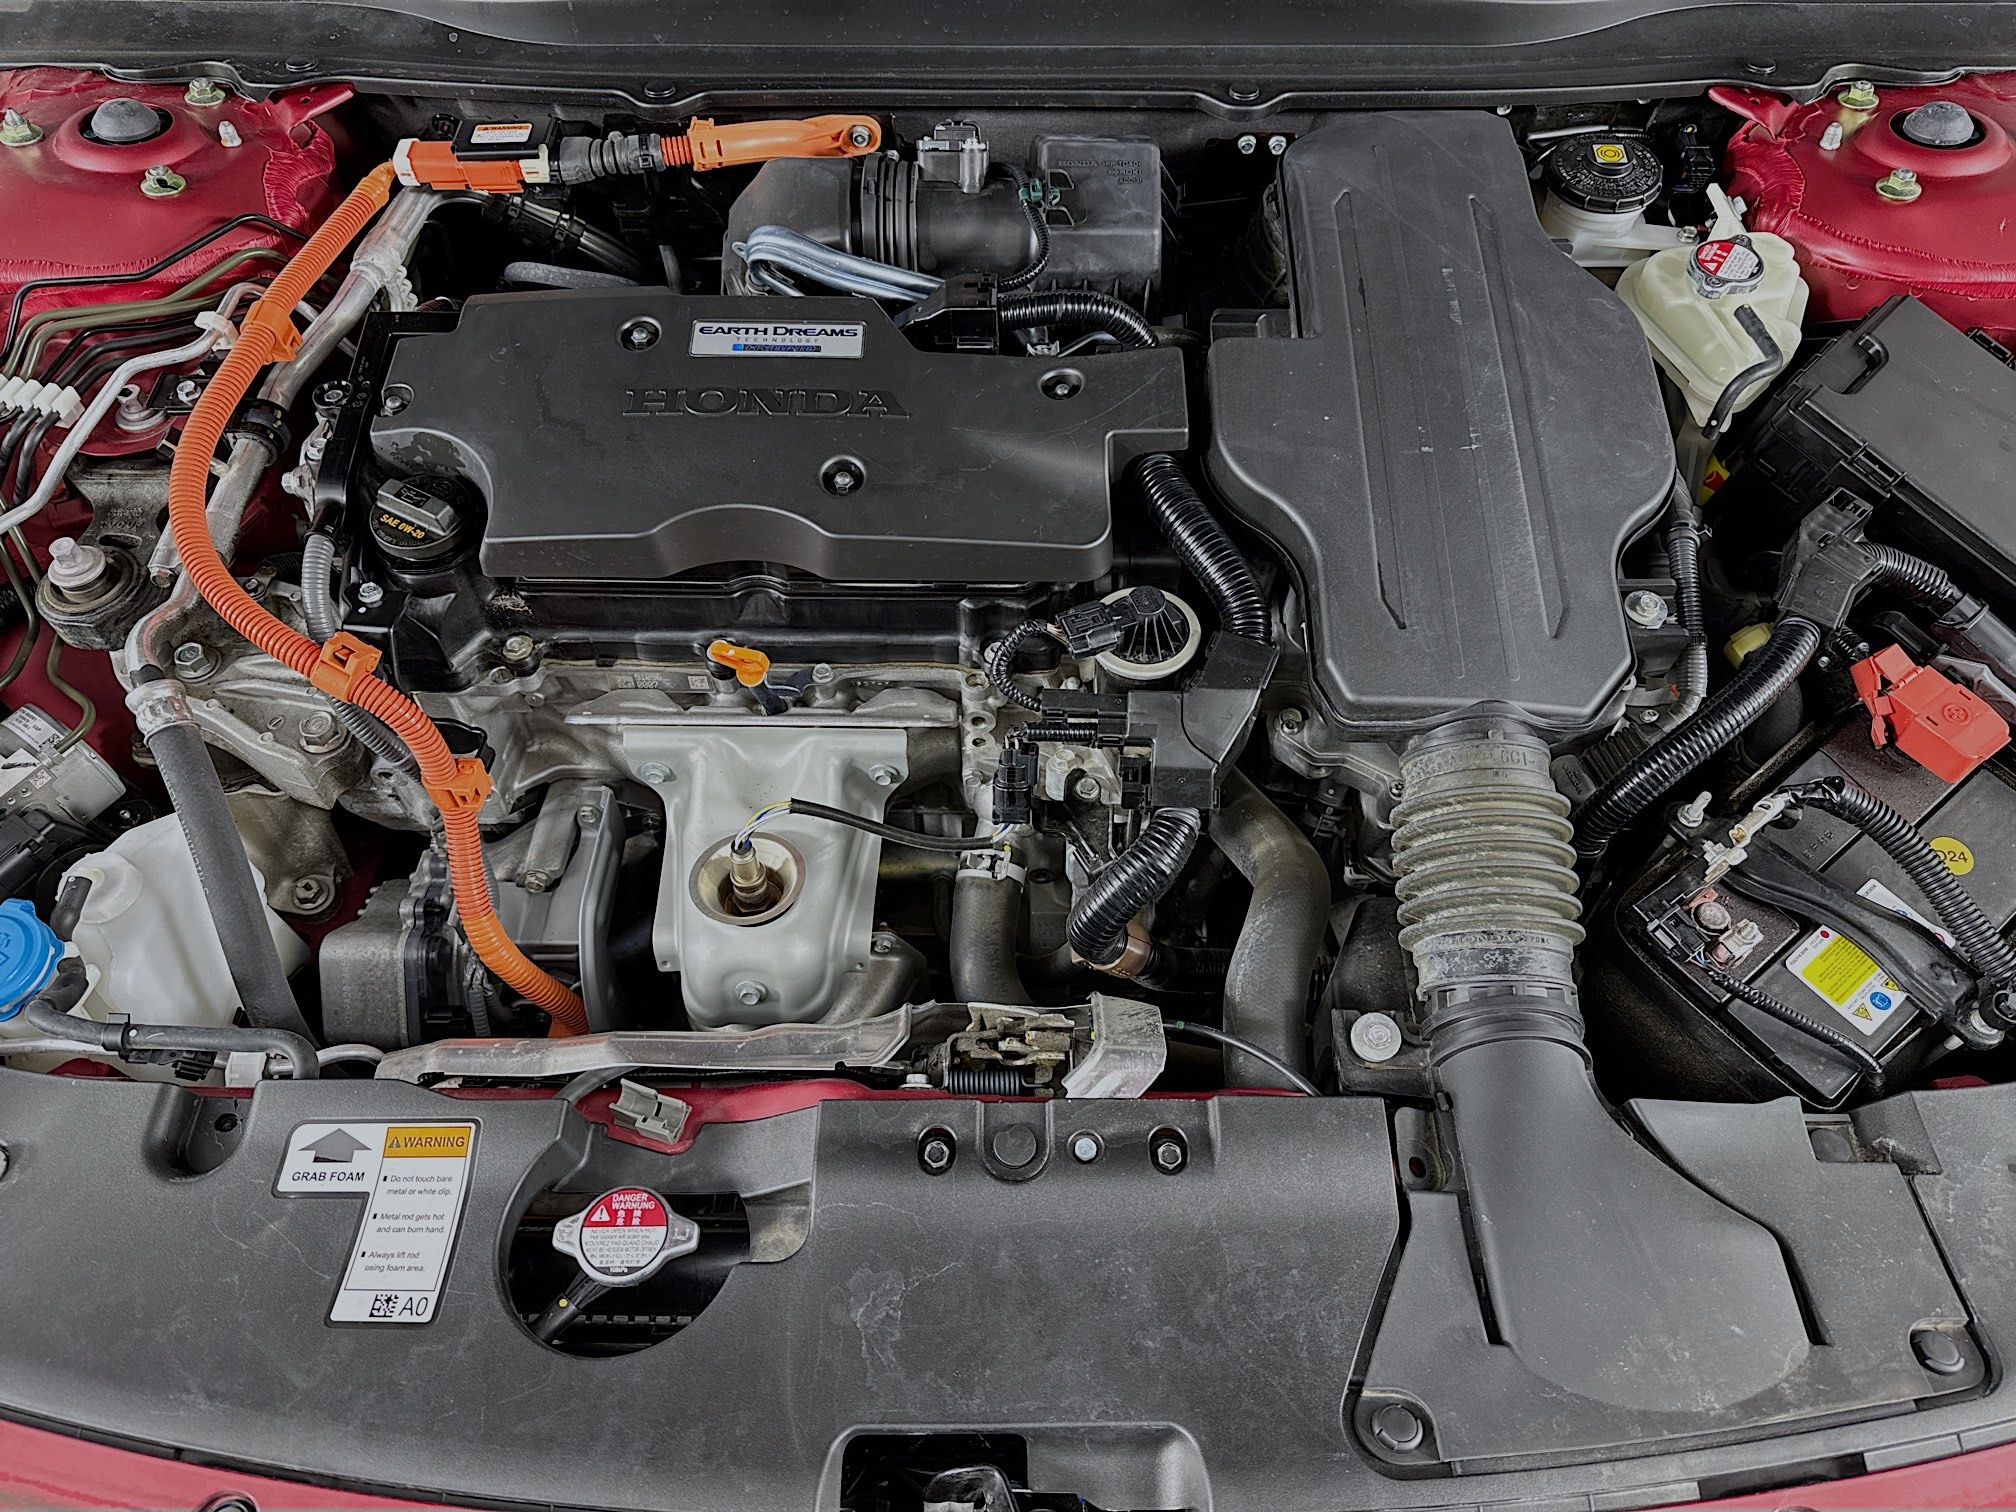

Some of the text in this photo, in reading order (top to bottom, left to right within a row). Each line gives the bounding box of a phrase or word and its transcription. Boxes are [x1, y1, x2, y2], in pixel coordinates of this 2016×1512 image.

[699, 326, 858, 337] EARTH DREAMS
[622, 387, 910, 419] HONDA
[380, 514, 425, 539] SAE 0W-20
[403, 1136, 465, 1148] WARNING
[291, 1171, 365, 1182] GRAB FOAM
[437, 1188, 453, 1196] clip.
[612, 1193, 649, 1202] DANGER
[611, 1201, 656, 1210] WARNUNG
[380, 1213, 445, 1222] Metal rod gets hot
[368, 1251, 420, 1260] Always lift rod
[364, 1265, 385, 1273] using
[386, 1264, 406, 1272] foam
[398, 1297, 429, 1316] A0
